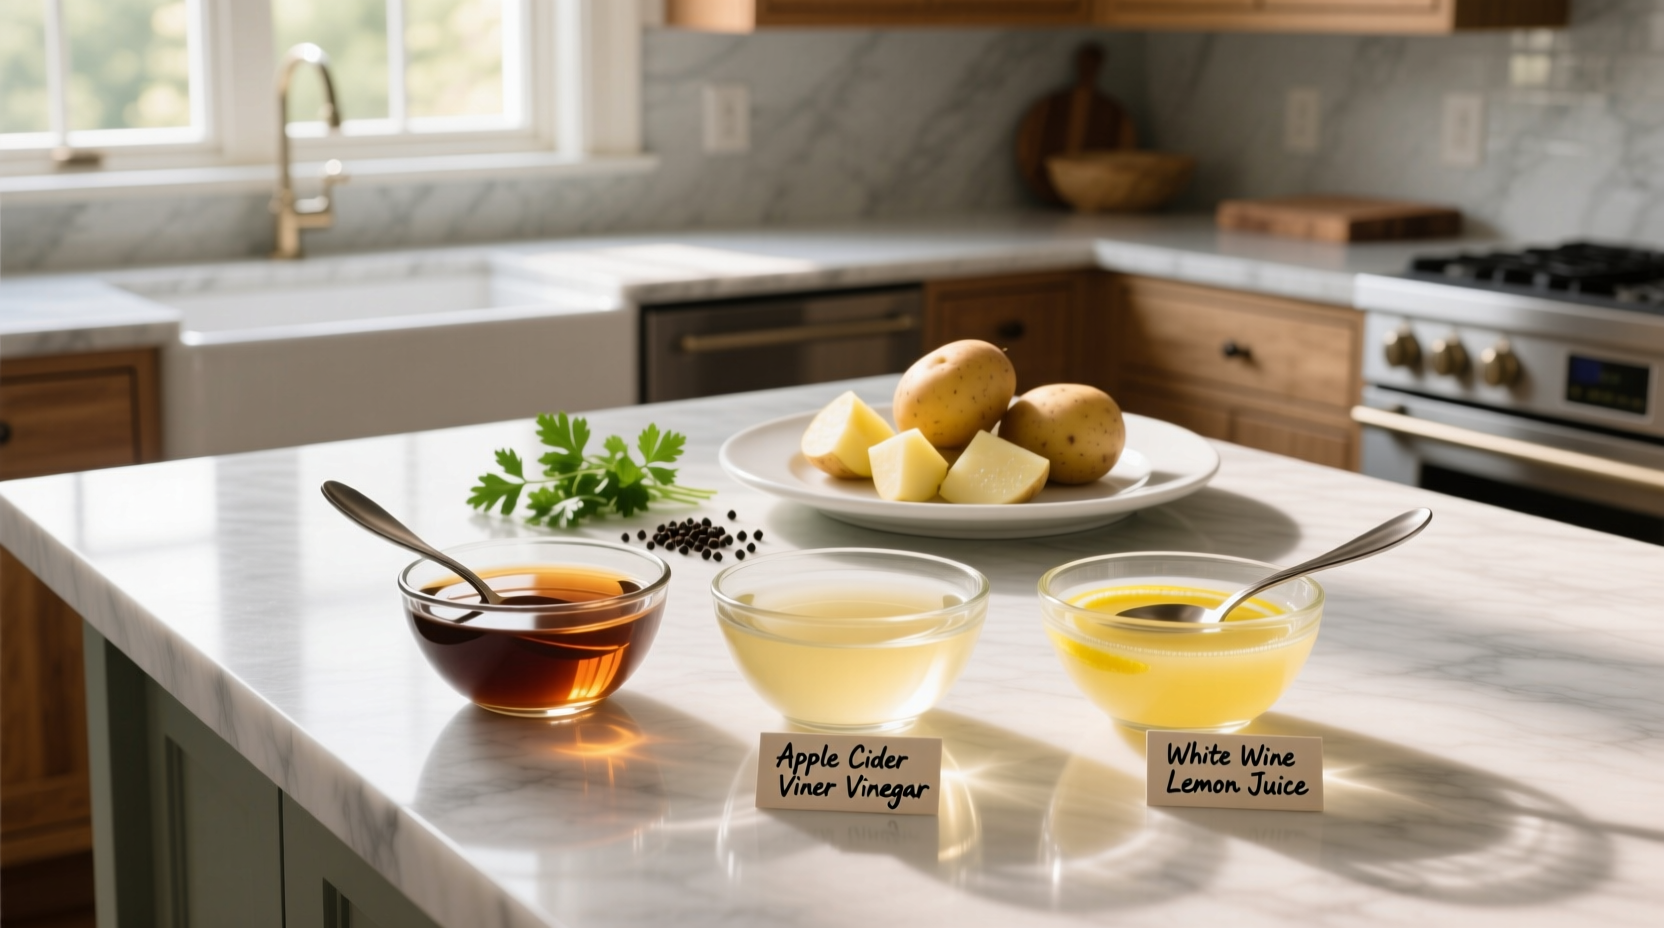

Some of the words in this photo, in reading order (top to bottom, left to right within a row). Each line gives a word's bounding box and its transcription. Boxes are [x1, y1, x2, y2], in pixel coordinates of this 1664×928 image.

[776, 742, 840, 776] Apple
[848, 744, 909, 770] Cider
[1167, 741, 1231, 766] White
[1241, 744, 1296, 767] Wine
[779, 774, 837, 798] Viner
[846, 774, 930, 810] Vinegar
[1166, 769, 1241, 794] Lemon
[1247, 771, 1310, 796] Juice
